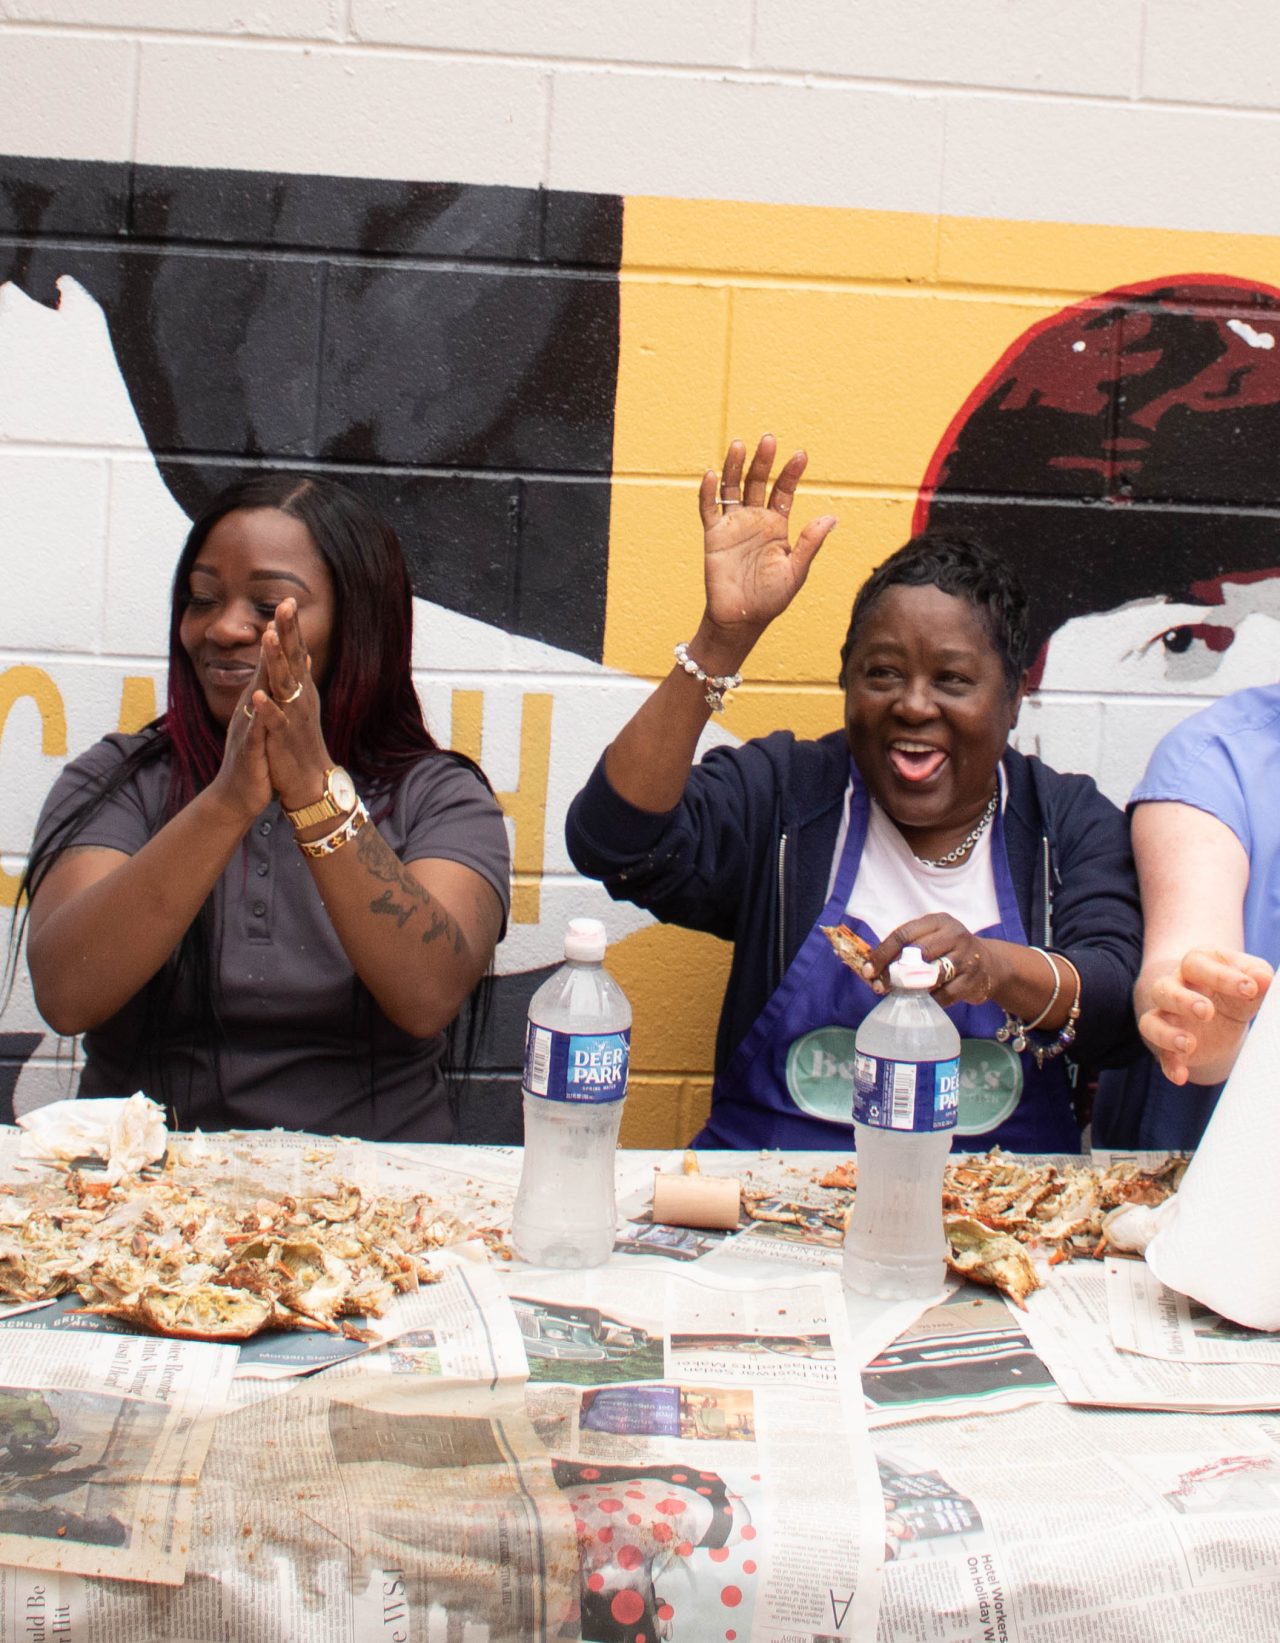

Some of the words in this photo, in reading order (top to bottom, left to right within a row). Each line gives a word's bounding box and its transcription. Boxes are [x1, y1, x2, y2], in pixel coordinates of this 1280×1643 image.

[574, 1048, 622, 1066] DEER
[573, 1064, 622, 1084] PARK
[166, 1340, 188, 1361] oice
[967, 1556, 978, 1575] On
[26, 1585, 46, 1609] Be
[382, 1567, 406, 1627] WSJ
[829, 1589, 855, 1630] A
[972, 1576, 991, 1625] Holiday
[981, 1553, 1000, 1586] Hotel
[991, 1586, 1009, 1643] Workers
[26, 1616, 46, 1643] uld
[51, 1604, 71, 1634] Hit
